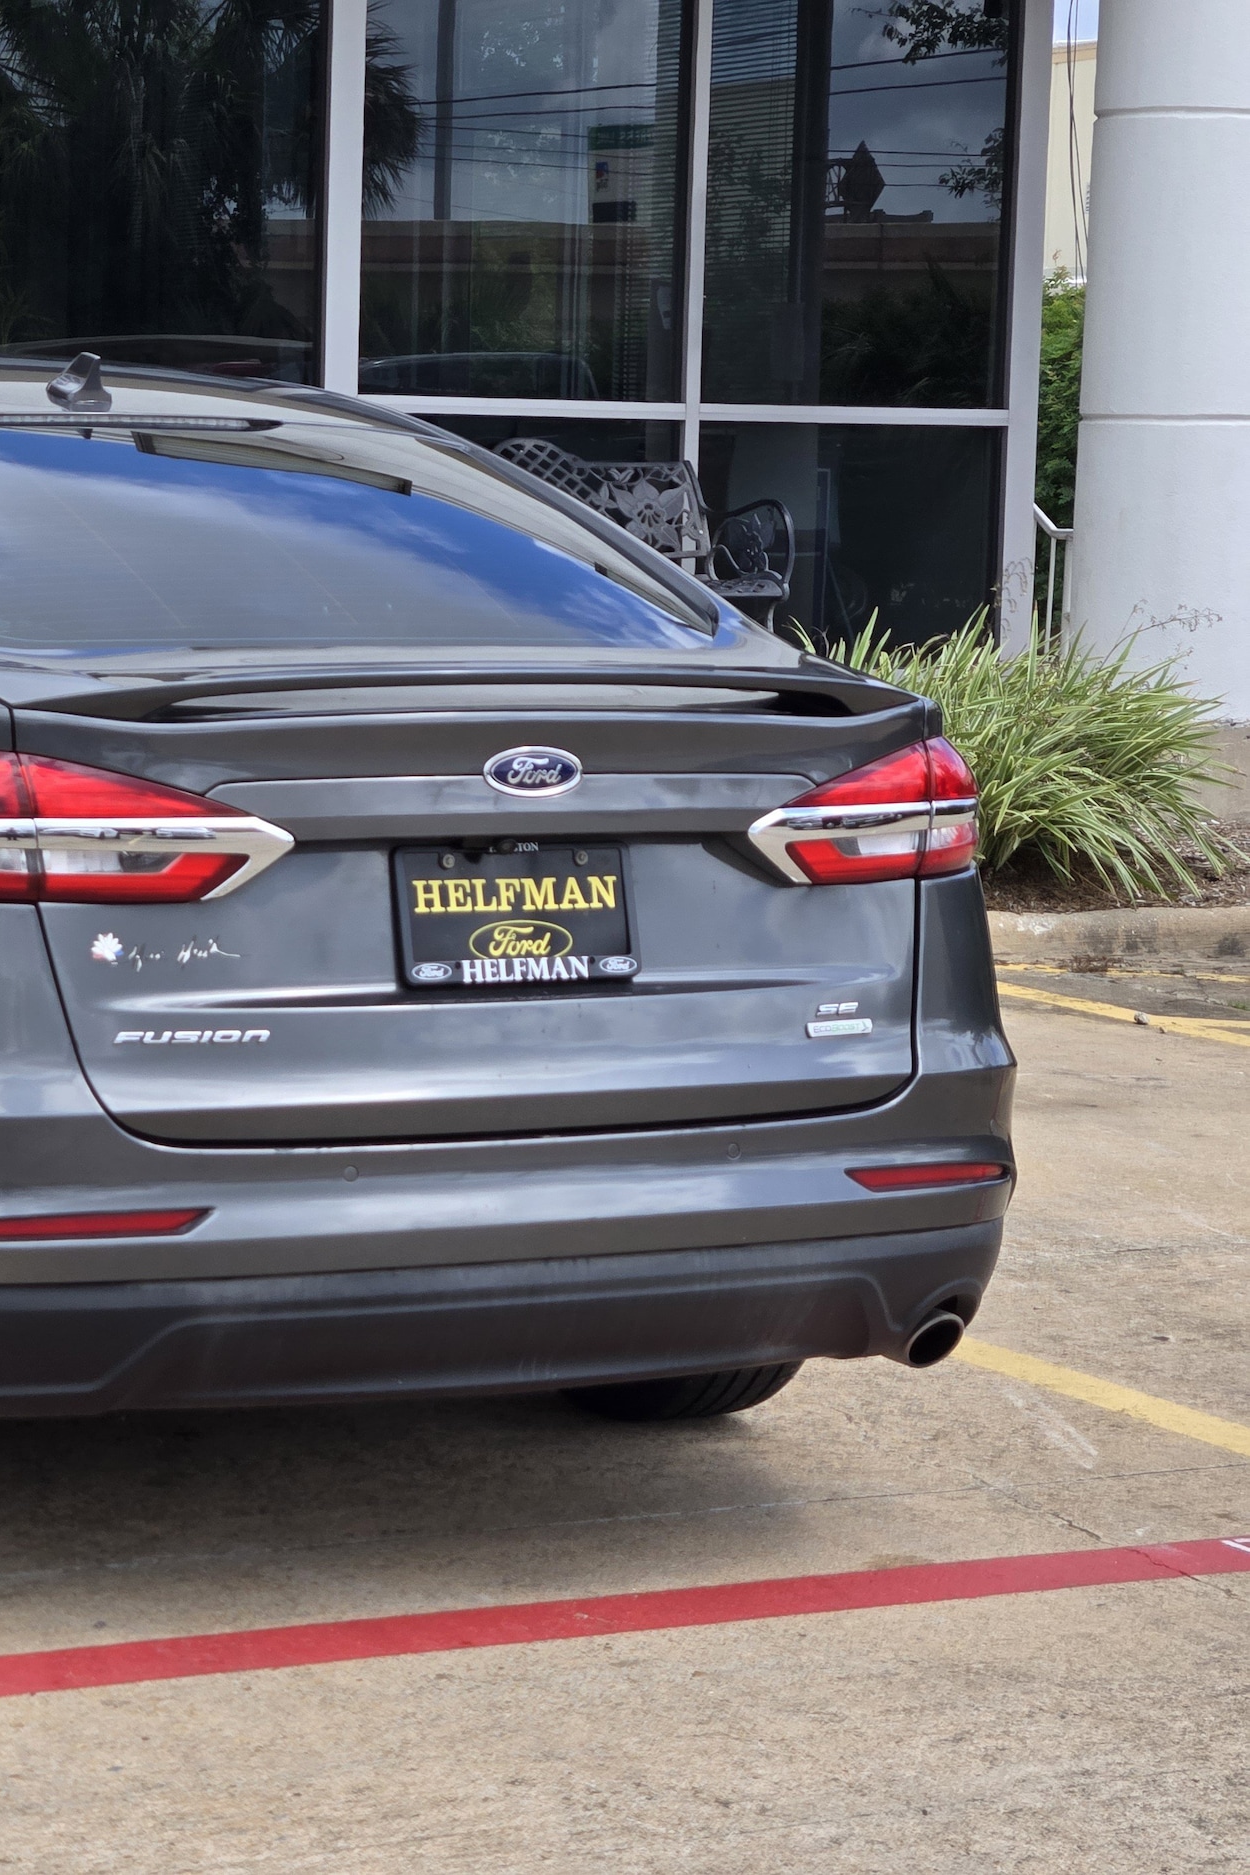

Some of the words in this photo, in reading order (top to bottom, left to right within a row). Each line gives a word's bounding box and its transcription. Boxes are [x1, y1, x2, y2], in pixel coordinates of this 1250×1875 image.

[507, 756, 563, 785] Ford
[412, 875, 617, 913] HELFMAN
[488, 925, 552, 957] Ford
[461, 955, 590, 984] HELFMAN
[816, 1002, 859, 1016] SE
[113, 1029, 271, 1044] FUSION
